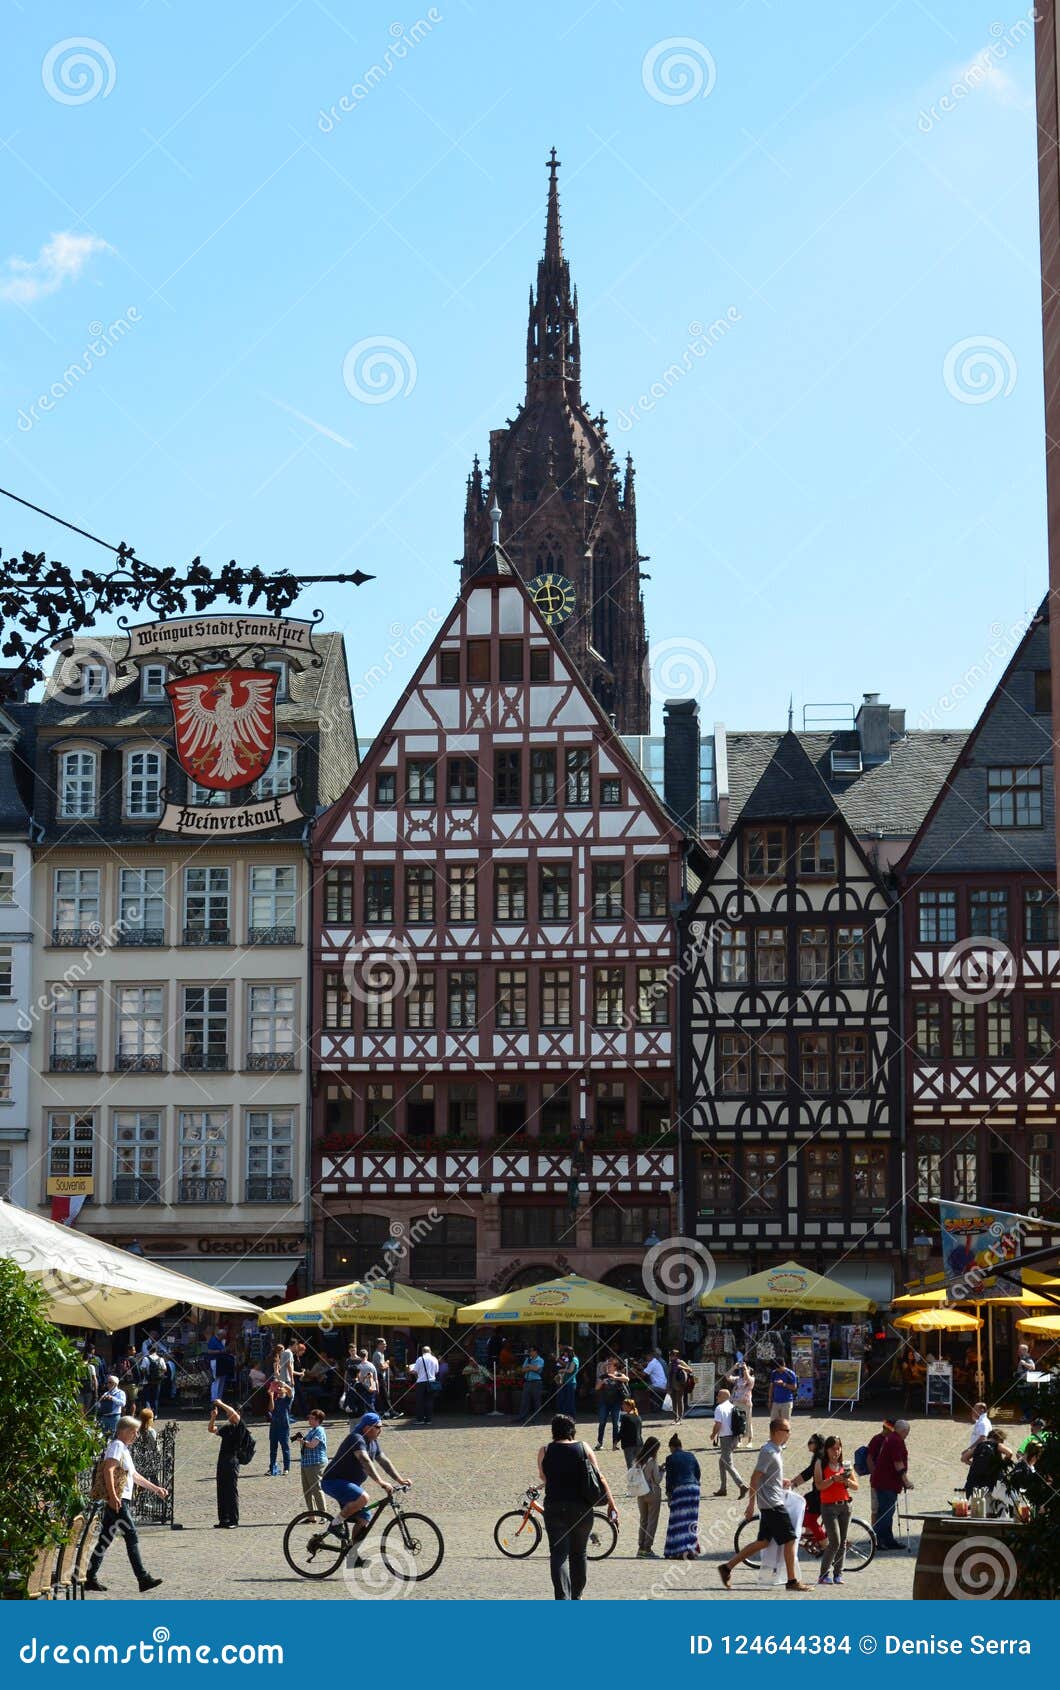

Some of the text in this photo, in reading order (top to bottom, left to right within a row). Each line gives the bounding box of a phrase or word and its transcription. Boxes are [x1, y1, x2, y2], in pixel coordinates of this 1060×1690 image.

[136, 619, 305, 646] Weingut Stadt Frankfurt
[177, 800, 284, 831] Weinverkauf
[197, 1237, 299, 1255] Geschenke
